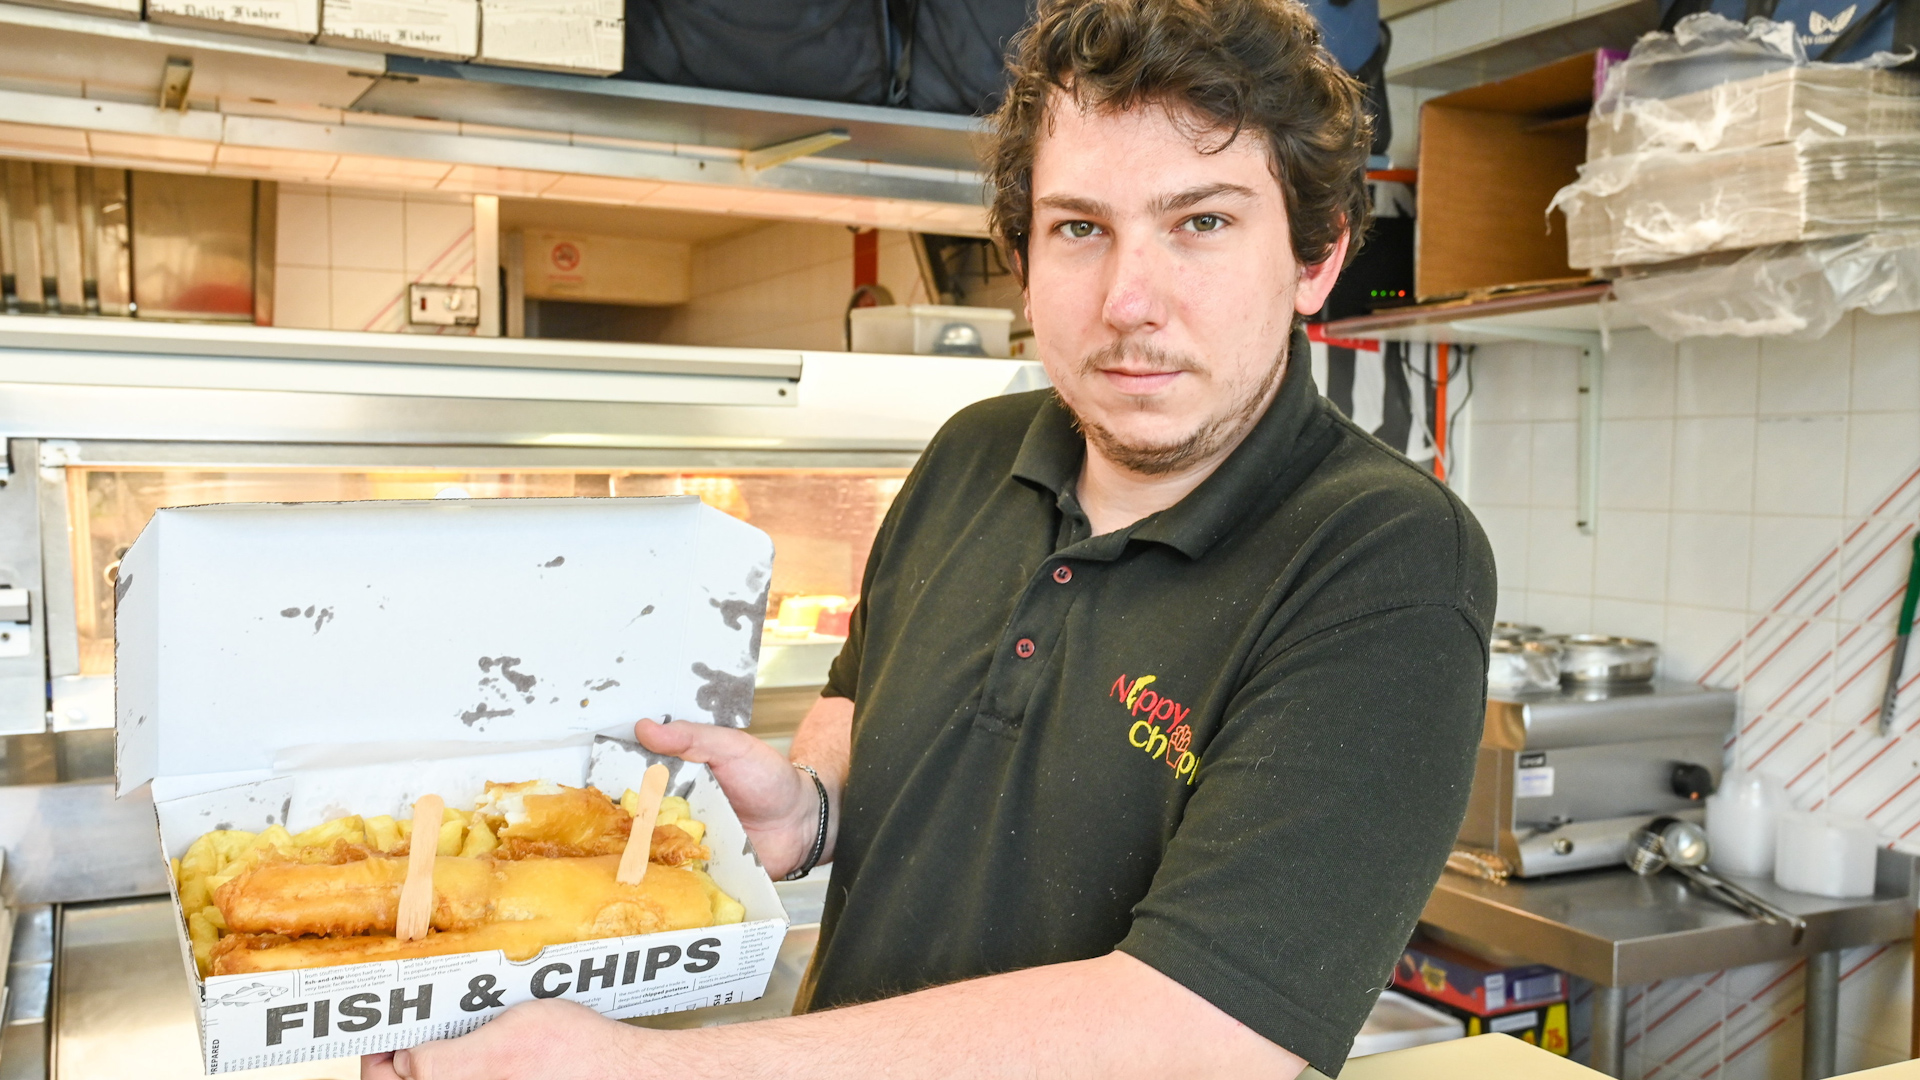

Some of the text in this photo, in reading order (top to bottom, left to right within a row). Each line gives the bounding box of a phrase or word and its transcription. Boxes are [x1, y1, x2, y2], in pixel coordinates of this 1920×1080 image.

[1109, 673, 1191, 734] Nippy
[266, 937, 722, 1047] FISH & CHIPS
[724, 990, 733, 1005] TR
